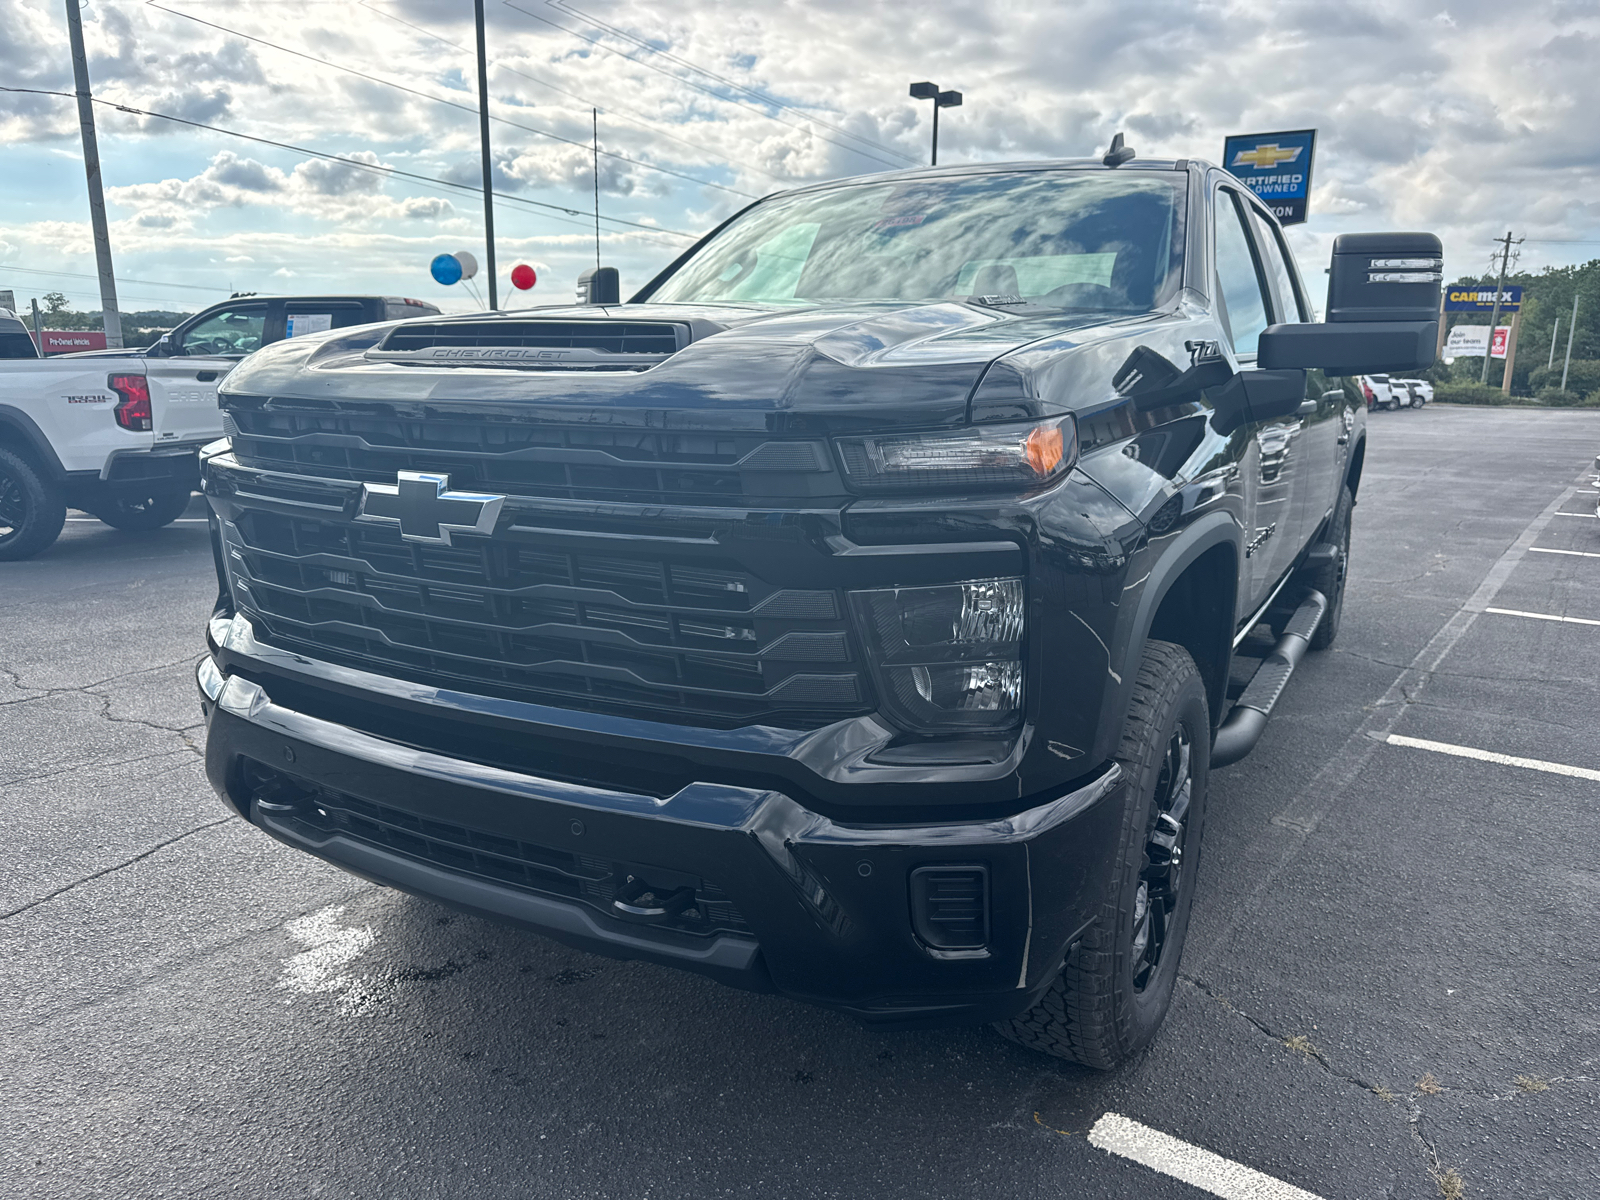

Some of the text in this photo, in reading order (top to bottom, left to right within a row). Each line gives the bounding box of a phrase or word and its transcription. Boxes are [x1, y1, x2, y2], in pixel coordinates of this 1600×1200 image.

[1239, 174, 1302, 185] ERTIFIED
[49, 338, 90, 346] Pre-Owned Vehicles
[432, 349, 571, 359] CHEVROLET
[168, 391, 217, 402] CHEVR
